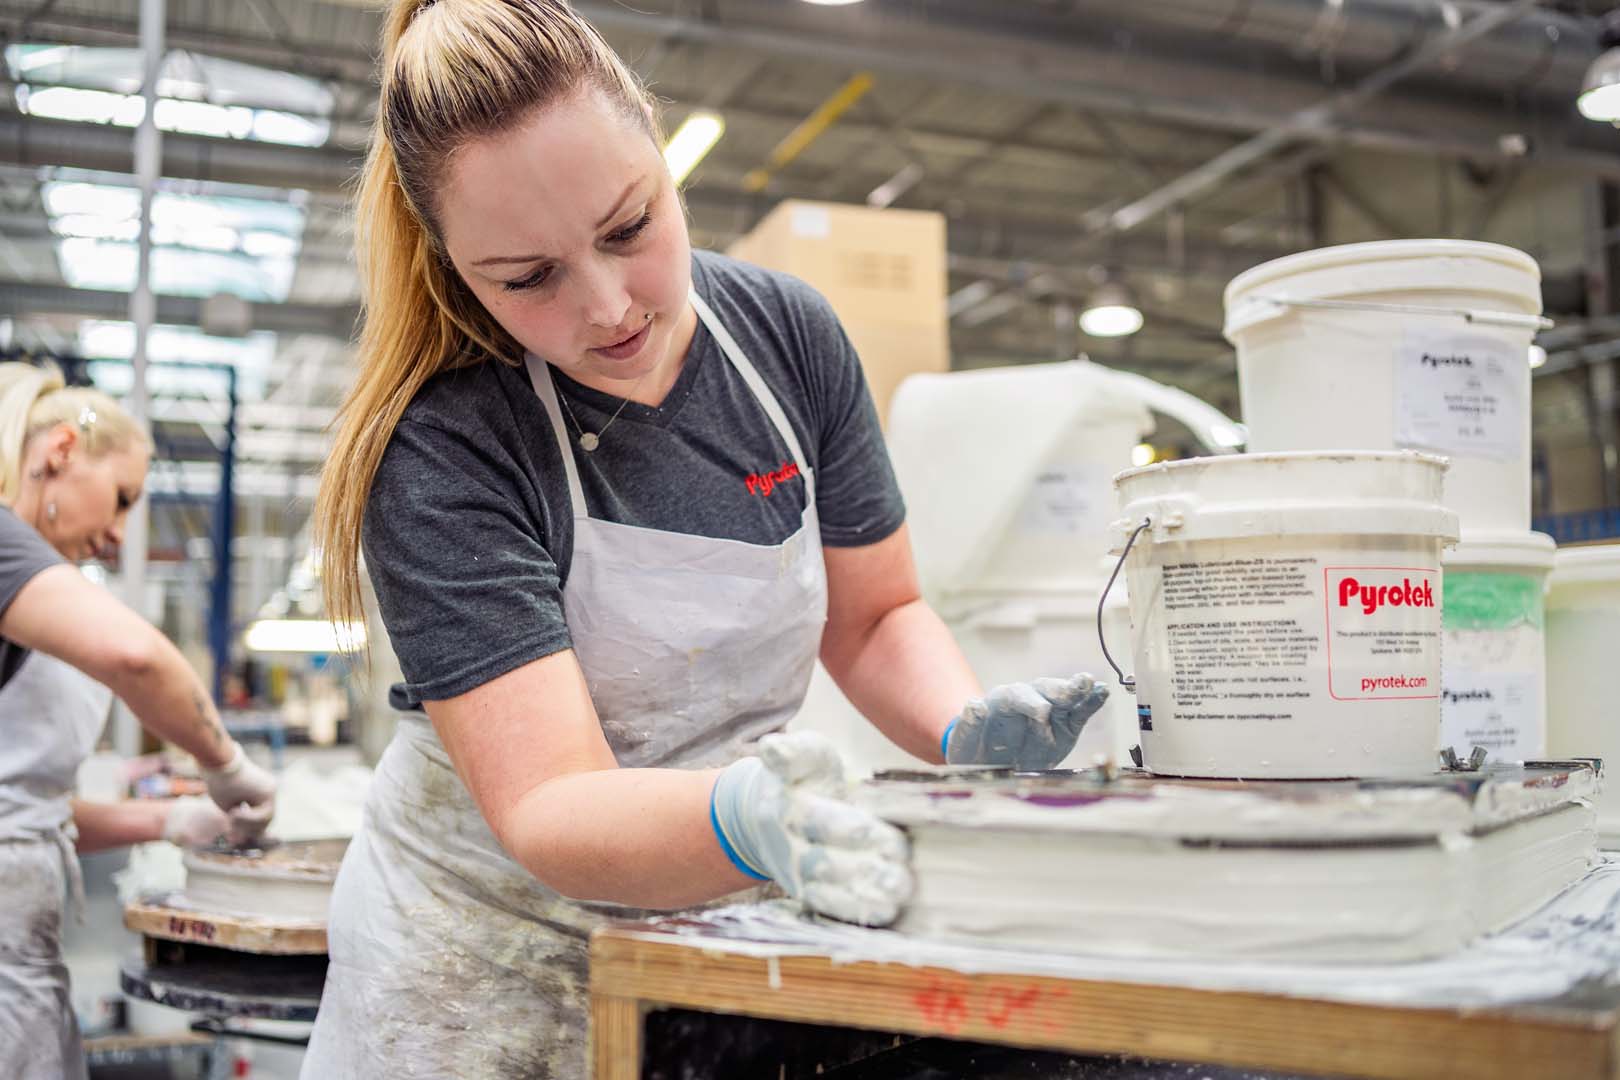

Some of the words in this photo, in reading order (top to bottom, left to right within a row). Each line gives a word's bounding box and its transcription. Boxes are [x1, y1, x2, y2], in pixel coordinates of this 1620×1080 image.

[745, 461, 799, 497] Pyrote
[1339, 577, 1434, 615] Pyrotek
[1361, 674, 1427, 692] pyrotek.com
